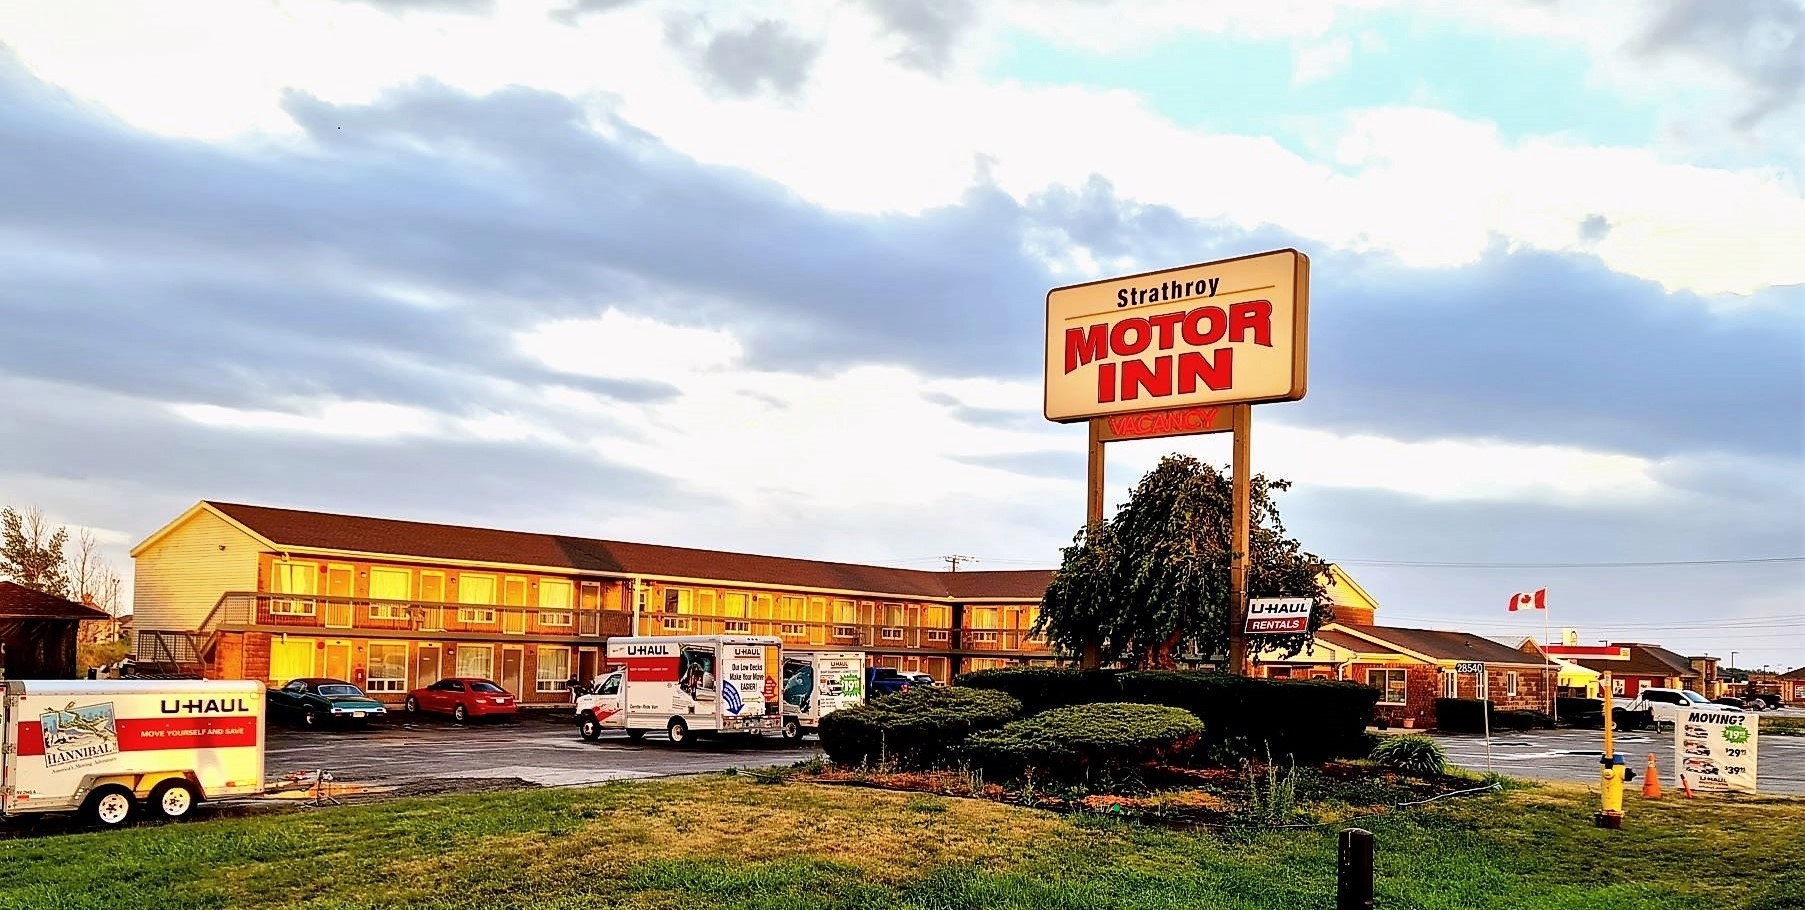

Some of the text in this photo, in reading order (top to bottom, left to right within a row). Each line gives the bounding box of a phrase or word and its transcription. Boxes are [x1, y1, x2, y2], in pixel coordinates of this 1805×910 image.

[1117, 277, 1219, 308] Strathroy
[1065, 299, 1273, 375] MOTOR
[1098, 347, 1233, 403] INN
[1109, 408, 1218, 435] VACANCY
[1251, 603, 1308, 613] U-HAUL
[1252, 620, 1300, 630] RENTALS
[627, 645, 669, 655] U-HAUL
[1457, 663, 1483, 673] 28540
[161, 699, 249, 713] U-HAUL
[1688, 712, 1745, 725] MOVING?
[141, 730, 165, 738] MOVE
[167, 729, 206, 737] YOURSELF
[224, 727, 245, 735] SAVE
